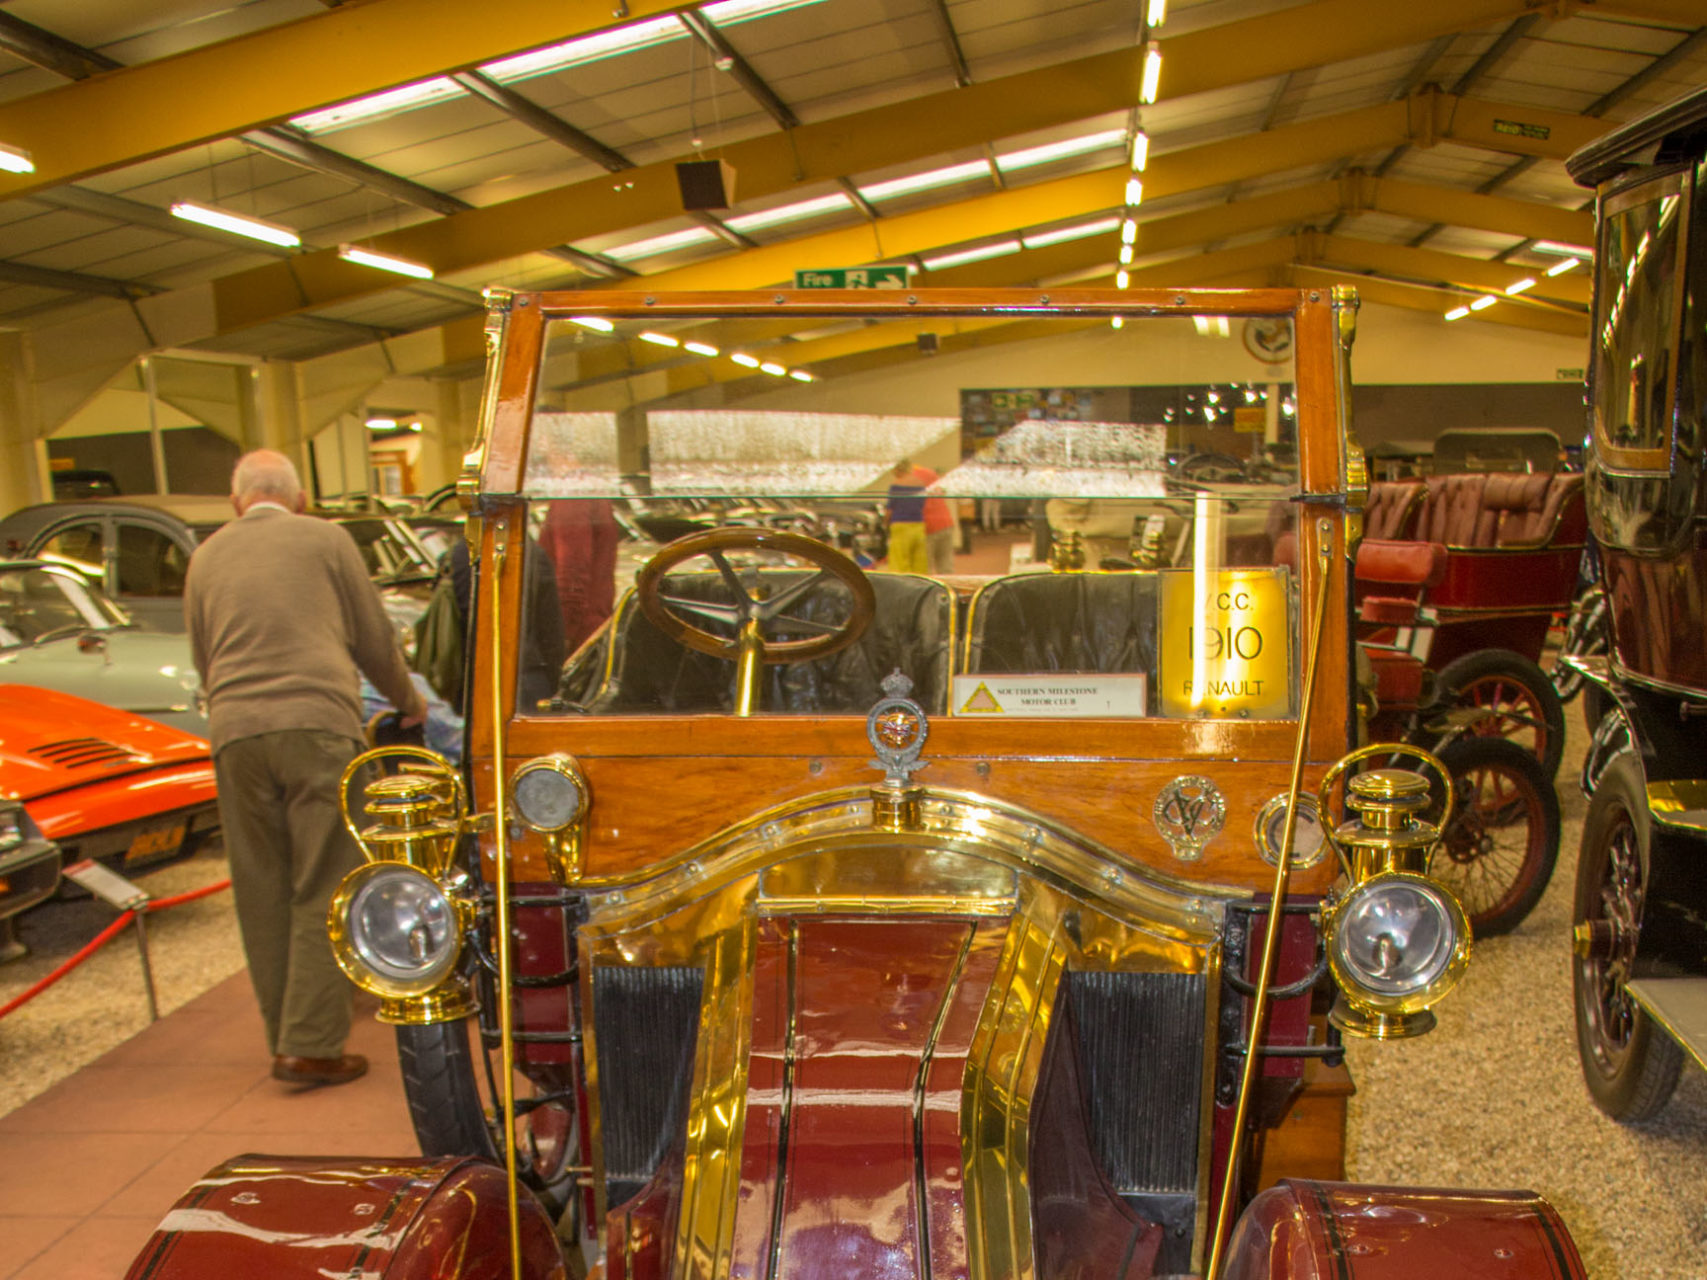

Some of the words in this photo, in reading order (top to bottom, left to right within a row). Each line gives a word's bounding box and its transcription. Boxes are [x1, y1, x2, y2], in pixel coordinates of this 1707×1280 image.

[803, 272, 833, 287] Fire
[1188, 626, 1264, 660] 1910
[997, 687, 1046, 695] SOUTHERN
[1048, 687, 1098, 695] MILESTONE
[1183, 680, 1265, 696] RNAULT
[1021, 698, 1052, 706] MOTOR
[1053, 698, 1077, 706] CLUB
